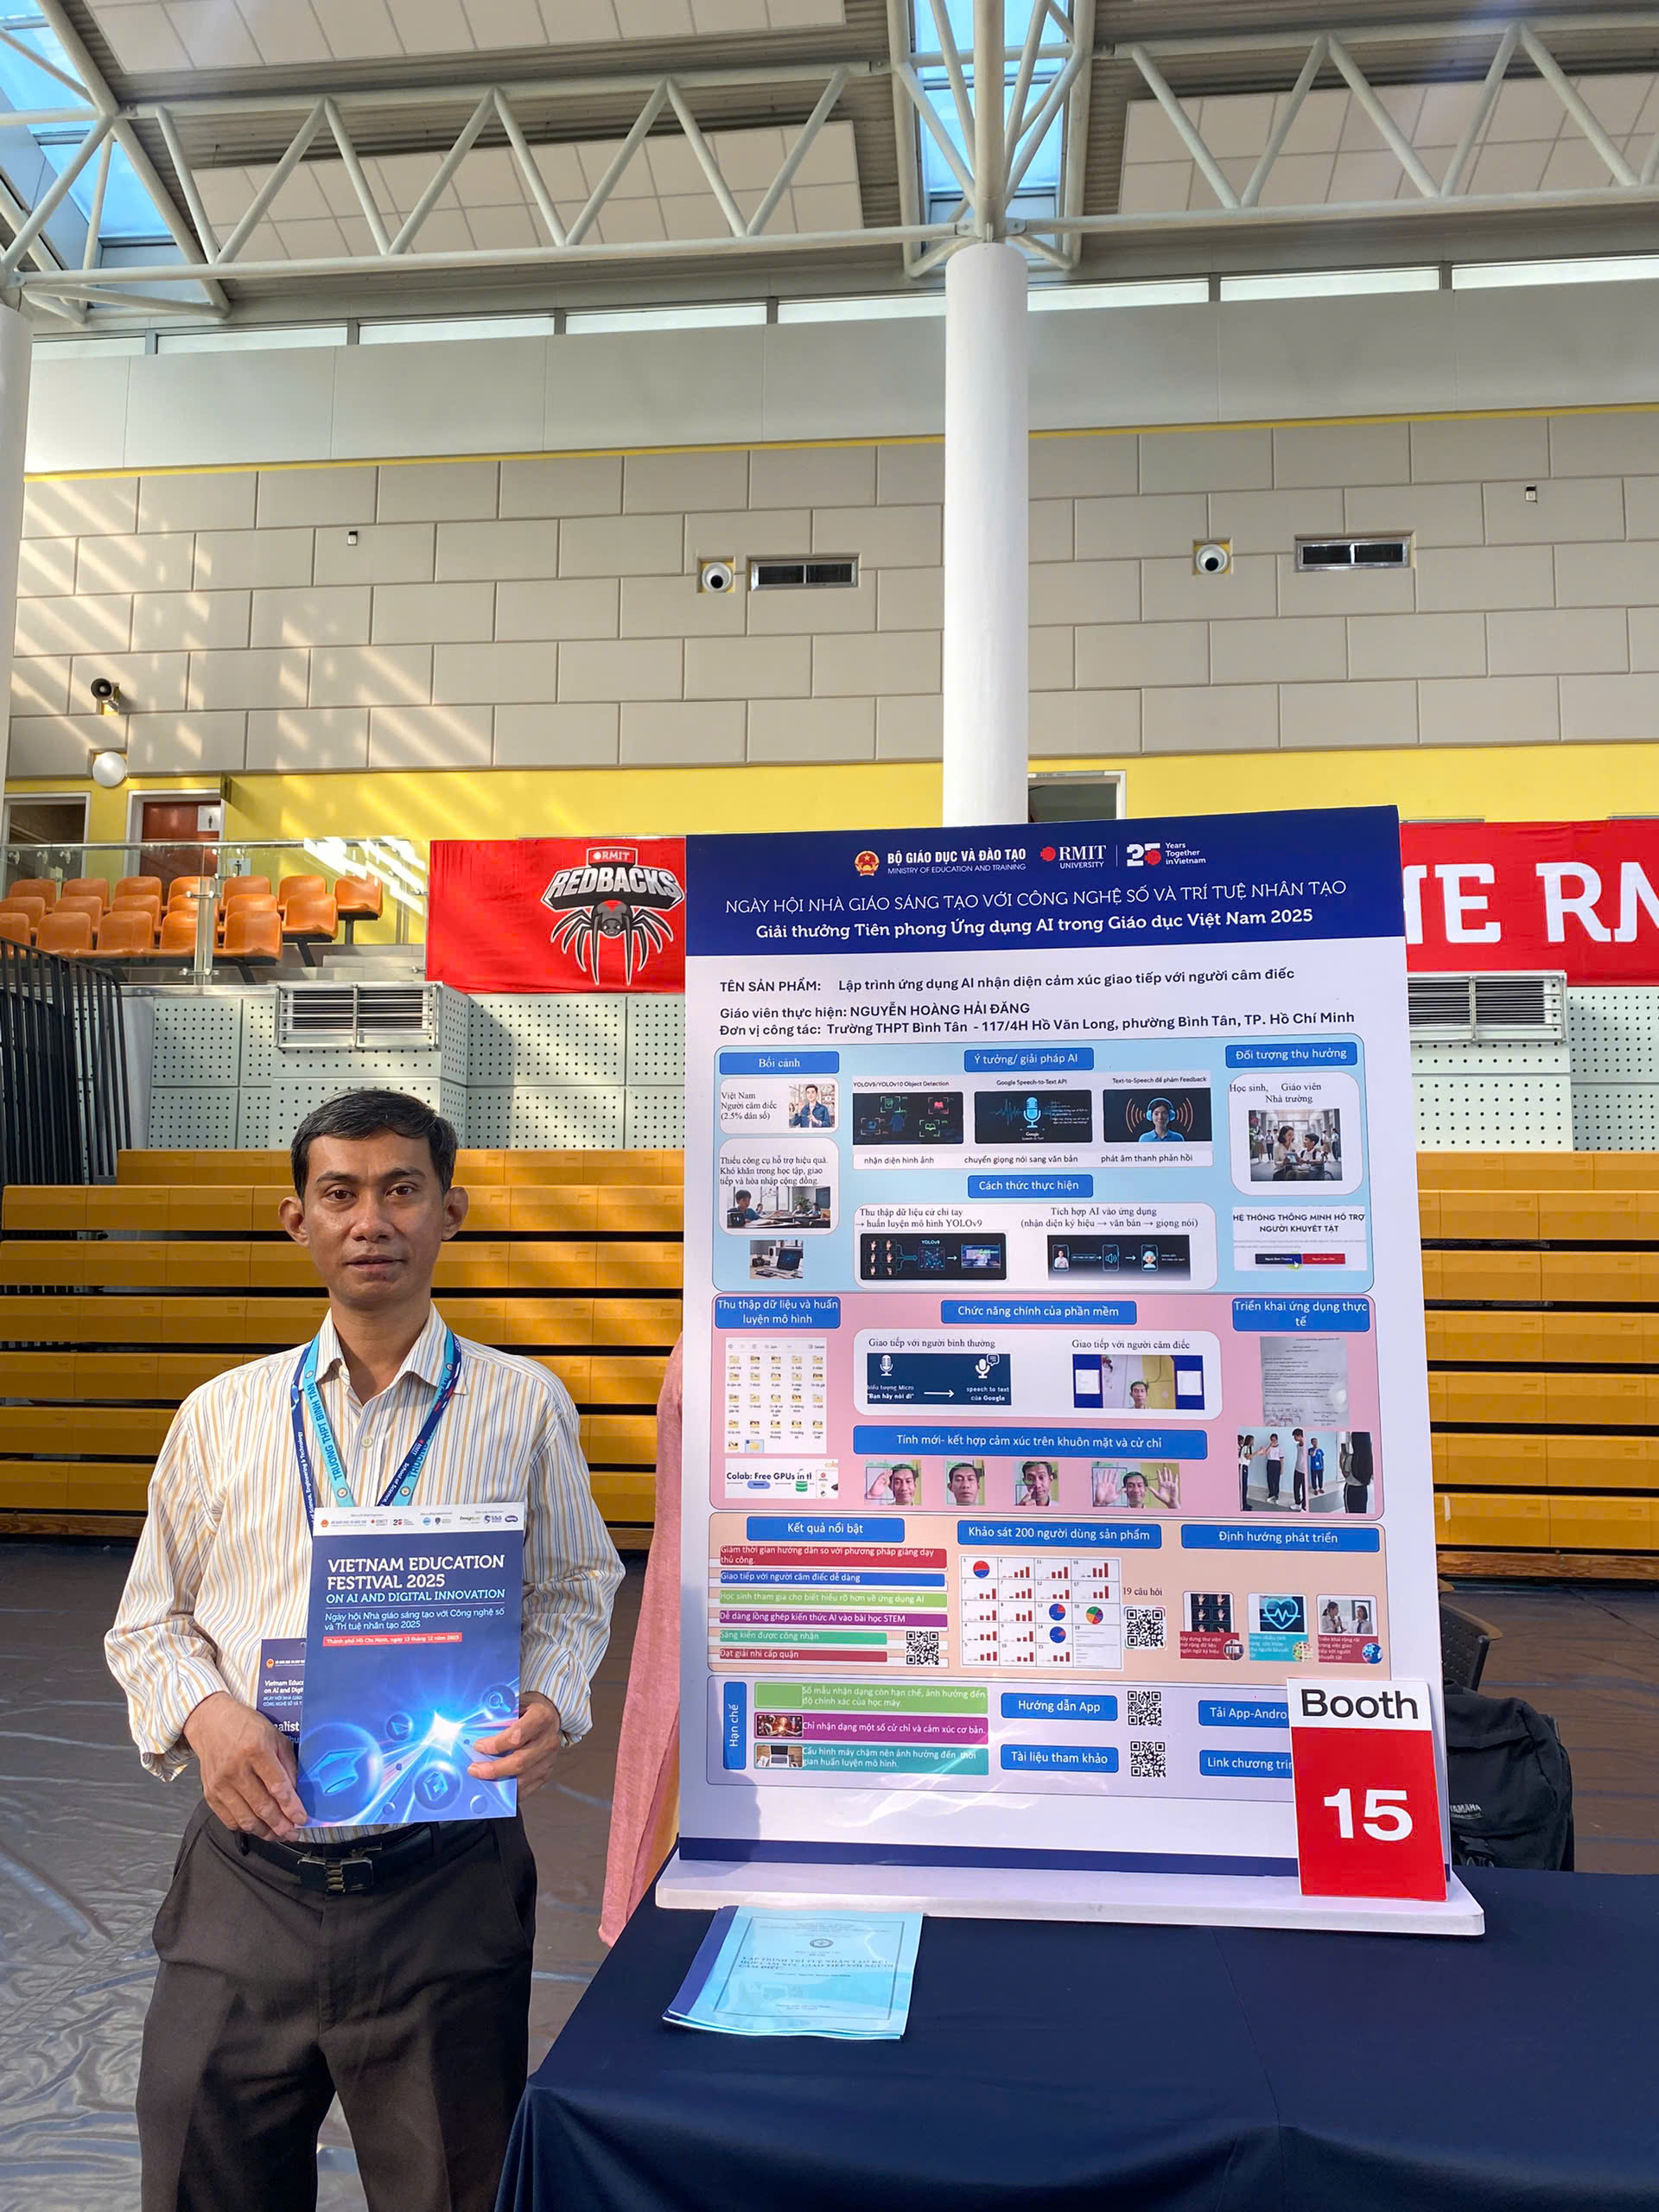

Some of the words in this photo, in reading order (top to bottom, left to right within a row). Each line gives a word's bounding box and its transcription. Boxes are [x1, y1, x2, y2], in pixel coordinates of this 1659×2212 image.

[602, 851, 630, 861] RMIT
[887, 850, 903, 866] BỘ
[906, 849, 931, 864] GIÁO
[936, 849, 957, 864] DỤC
[961, 849, 975, 862] VÀ
[979, 849, 1001, 861] ĐÀO
[1005, 849, 1026, 862] TẠO
[1059, 844, 1106, 861] RMIT
[1127, 843, 1160, 867] 25
[548, 867, 683, 899] REDBACKS
[726, 898, 769, 913] NGÀY
[774, 896, 804, 914] HỘI
[809, 896, 843, 912] NHÀ
[849, 894, 889, 911] GIÁO
[894, 893, 939, 910] SÁNG
[944, 894, 978, 911] TẠO
[983, 892, 1012, 908] VỚI
[1017, 890, 1068, 906] CÔNG
[1073, 887, 1122, 905] NGHỆ
[1127, 886, 1149, 902] SỐ
[1154, 887, 1177, 901] VÀ
[1181, 883, 1208, 900] TRÍ
[1213, 885, 1246, 900] TUỆ
[1251, 881, 1303, 897] NHÂN
[1309, 880, 1346, 898] TẠO
[756, 924, 787, 938] Giải
[792, 923, 850, 941] thưởng
[855, 923, 890, 937] Tiên
[895, 921, 946, 938] phong
[950, 918, 985, 938] Ứng
[989, 918, 1032, 936] dụng
[1036, 918, 1053, 931] AI
[1058, 917, 1103, 933] trong
[1109, 914, 1147, 930] Giáo
[1152, 913, 1182, 931] dục
[1187, 912, 1221, 928] Việt
[1226, 911, 1266, 925] Nam
[1271, 908, 1313, 924] 2025
[721, 980, 745, 992] TÊN
[748, 978, 775, 993] SẢN
[839, 979, 861, 993] Lập
[865, 977, 894, 990] trình
[899, 979, 923, 991] ứng
[926, 977, 958, 991] dụng
[961, 978, 974, 989] AI
[977, 976, 1009, 991] nhận
[1014, 976, 1041, 989] diện
[1046, 973, 1073, 987] cảm
[1077, 973, 1101, 985] xúc
[1104, 972, 1132, 987] giao
[1135, 970, 1161, 986] tiếp
[1166, 970, 1185, 983] với
[1189, 970, 1227, 984] người
[1231, 969, 1262, 981] câm
[1265, 967, 1294, 981] điếc
[721, 1007, 749, 1020] Giáo
[752, 1008, 779, 1018] viên
[781, 1007, 812, 1020] thực
[816, 1006, 846, 1019] hiện:
[850, 1001, 906, 1017] NGUYỄN
[911, 1003, 960, 1015] HOÀNG
[964, 1001, 987, 1014] HẢI
[990, 1001, 1029, 1014] ĐĂNG
[720, 1024, 746, 1036] Đơn
[747, 1025, 760, 1037] vị
[763, 1023, 794, 1038] công
[797, 1023, 821, 1034] tác:
[827, 1023, 873, 1037] Trường
[876, 1022, 910, 1033] THPT
[913, 1021, 940, 1033] Bình
[944, 1021, 967, 1033] Tân
[982, 1020, 1027, 1033] 117/4H
[1033, 1018, 1050, 1031] Hồ
[1054, 1018, 1080, 1030] Văn
[1083, 1018, 1118, 1033] Long,
[1122, 1015, 1175, 1031] phường
[1179, 1015, 1208, 1028] Bình
[1211, 1014, 1241, 1028] Tân,
[1245, 1014, 1266, 1026] TP.
[1270, 1013, 1289, 1025] Hồ
[1293, 1012, 1317, 1024] Chí
[1320, 1012, 1355, 1023] Minh
[759, 1056, 775, 1068] Bối
[779, 1058, 800, 1067] cảnh
[975, 1054, 981, 1064] Ý
[983, 1054, 1017, 1065] tưởng/
[1020, 1054, 1037, 1065] giải
[1040, 1054, 1065, 1065] pháp
[1236, 1050, 1253, 1060] Đối
[1256, 1050, 1288, 1061] tượng
[1292, 1049, 1309, 1060] thụ
[1313, 1048, 1346, 1059] hưởng
[885, 1156, 900, 1165] diện
[979, 1181, 1001, 1190] Cách
[1006, 1181, 1027, 1190] thức
[1031, 1181, 1054, 1191] thực
[1058, 1181, 1078, 1191] hiện
[958, 1306, 983, 1315] Chức
[987, 1306, 1011, 1318] năng
[1014, 1306, 1040, 1316] chính
[1044, 1306, 1061, 1316] của
[1065, 1306, 1090, 1318] phần
[1093, 1305, 1118, 1317] mềm
[328, 1558, 404, 1573] VIETNAM
[409, 1554, 505, 1571] EDUCATION
[327, 1575, 403, 1590] FESTIVAL
[407, 1573, 445, 1588] 2025
[327, 1594, 344, 1604] ON
[346, 1594, 358, 1603] AI
[361, 1593, 385, 1603] AND
[389, 1592, 431, 1602] DIGITAL
[435, 1589, 505, 1599] INNOVATION
[1018, 1700, 1054, 1713] Hướng
[1057, 1699, 1077, 1712] dẫn
[1079, 1702, 1100, 1713] App
[1301, 1688, 1419, 1719] Booth
[1210, 1707, 1225, 1717] Tải
[1229, 1707, 1287, 1719] App-Andro
[1012, 1751, 1027, 1762] Tài
[1029, 1752, 1048, 1764] liệu
[1052, 1752, 1079, 1763] tham
[1083, 1752, 1108, 1764] khảo
[1323, 1788, 1413, 1841] 15
